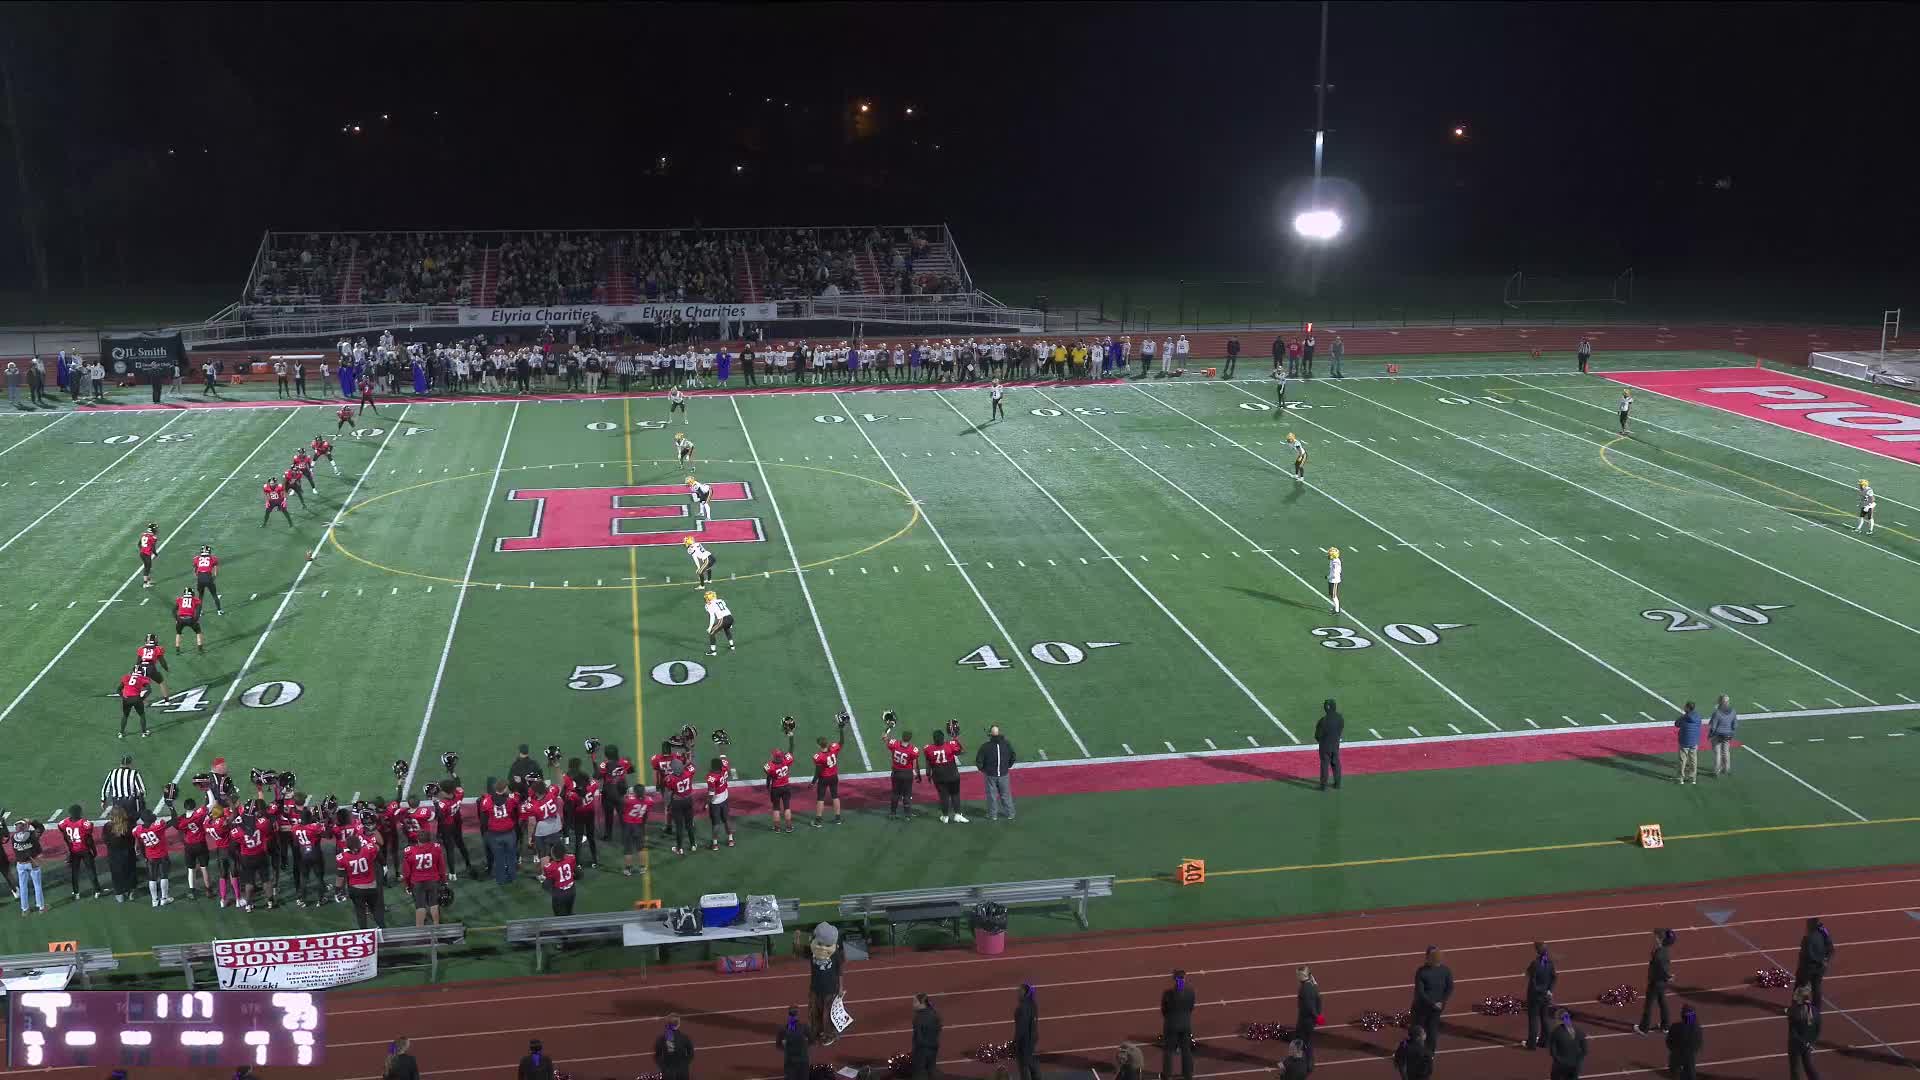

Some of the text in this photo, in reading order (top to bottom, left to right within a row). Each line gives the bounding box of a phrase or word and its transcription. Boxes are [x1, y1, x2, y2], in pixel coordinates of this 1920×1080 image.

[491, 308, 598, 324] Elyria Charities
[642, 305, 746, 319] Elyria Charities
[126, 346, 167, 358] JL Smith
[198, 556, 210, 567] 26
[933, 750, 947, 764] 71
[676, 777, 693, 794] 67
[540, 799, 558, 819] 75
[66, 826, 81, 843] 94
[295, 829, 312, 845] 31
[350, 858, 369, 875] 70
[415, 853, 433, 870] 73
[558, 863, 572, 883] 13
[216, 933, 374, 955] GOOD LUCK
[217, 945, 375, 967] PIONEERS!
